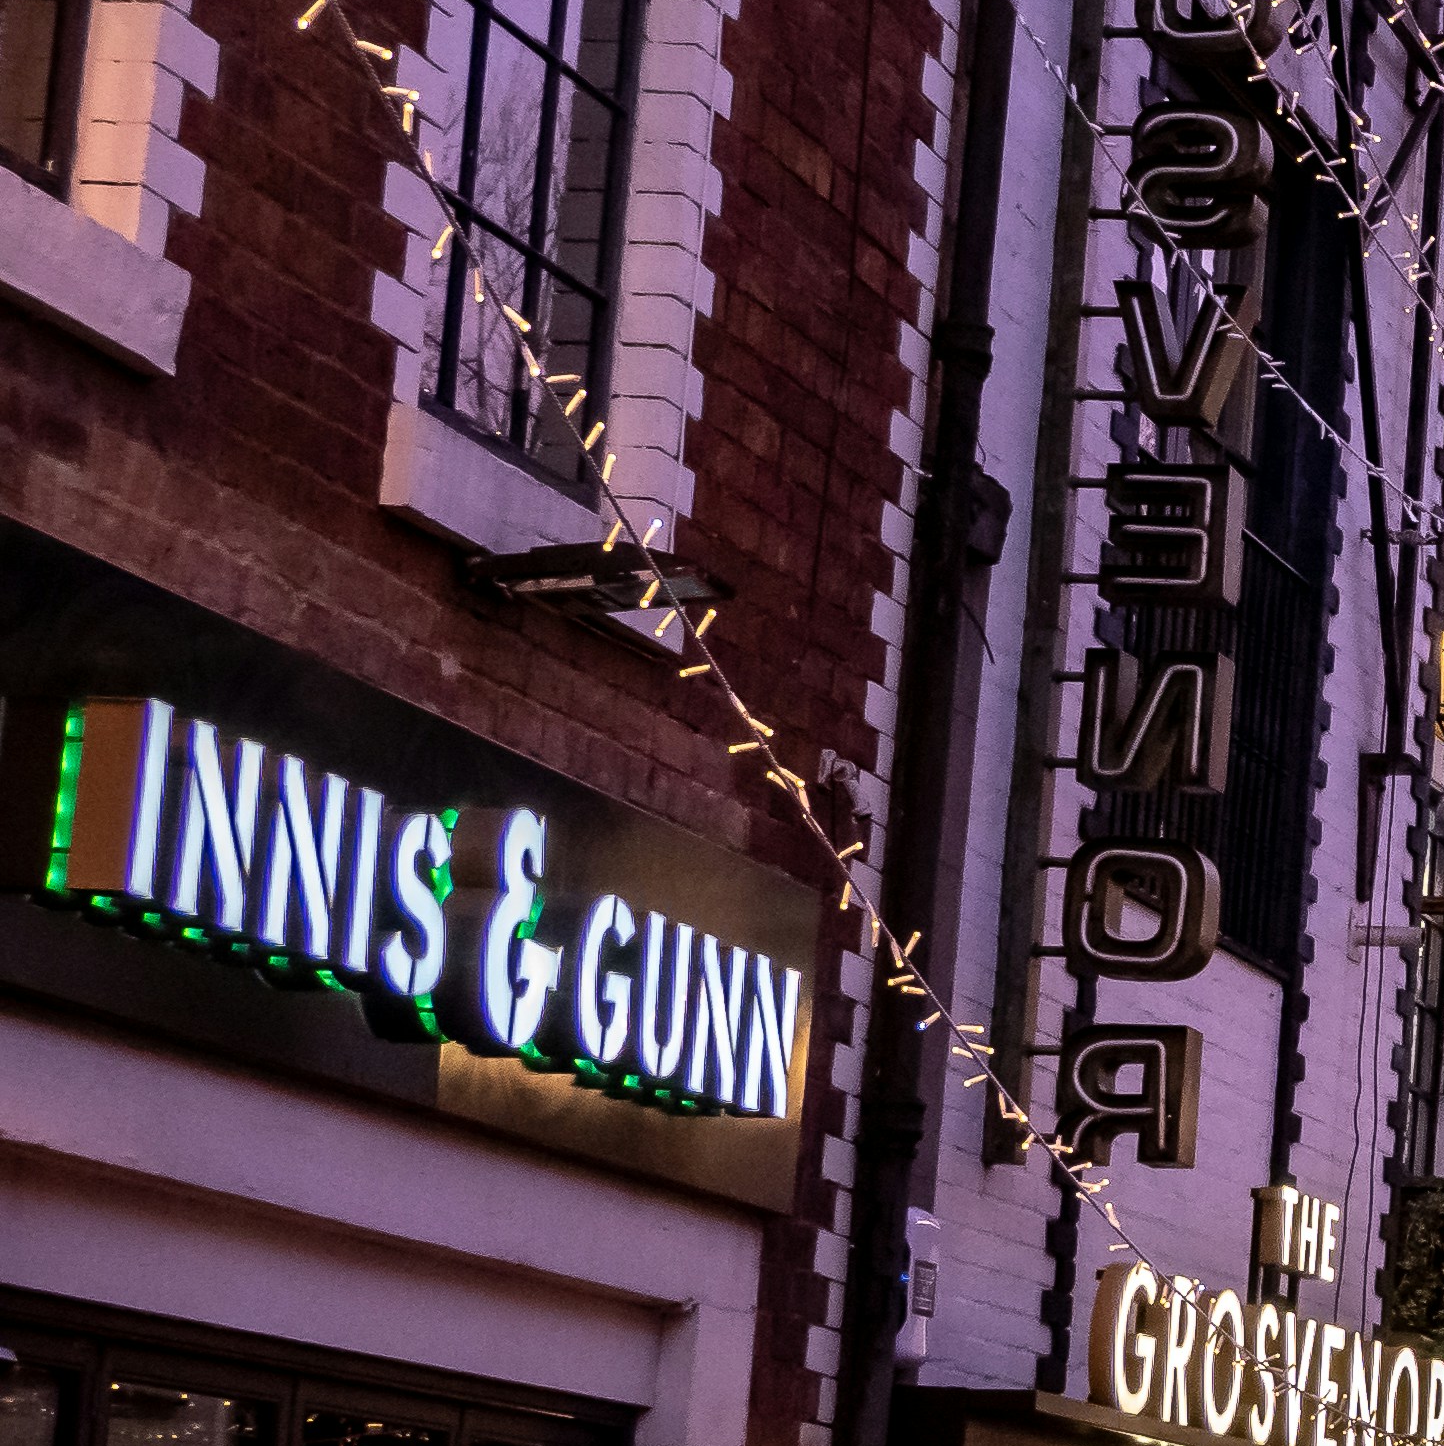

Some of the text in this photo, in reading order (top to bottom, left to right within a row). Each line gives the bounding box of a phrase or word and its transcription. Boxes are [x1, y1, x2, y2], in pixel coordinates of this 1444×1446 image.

[125, 697, 802, 1119] INNIS & GUNN
[1278, 1185, 1341, 1281] THE
